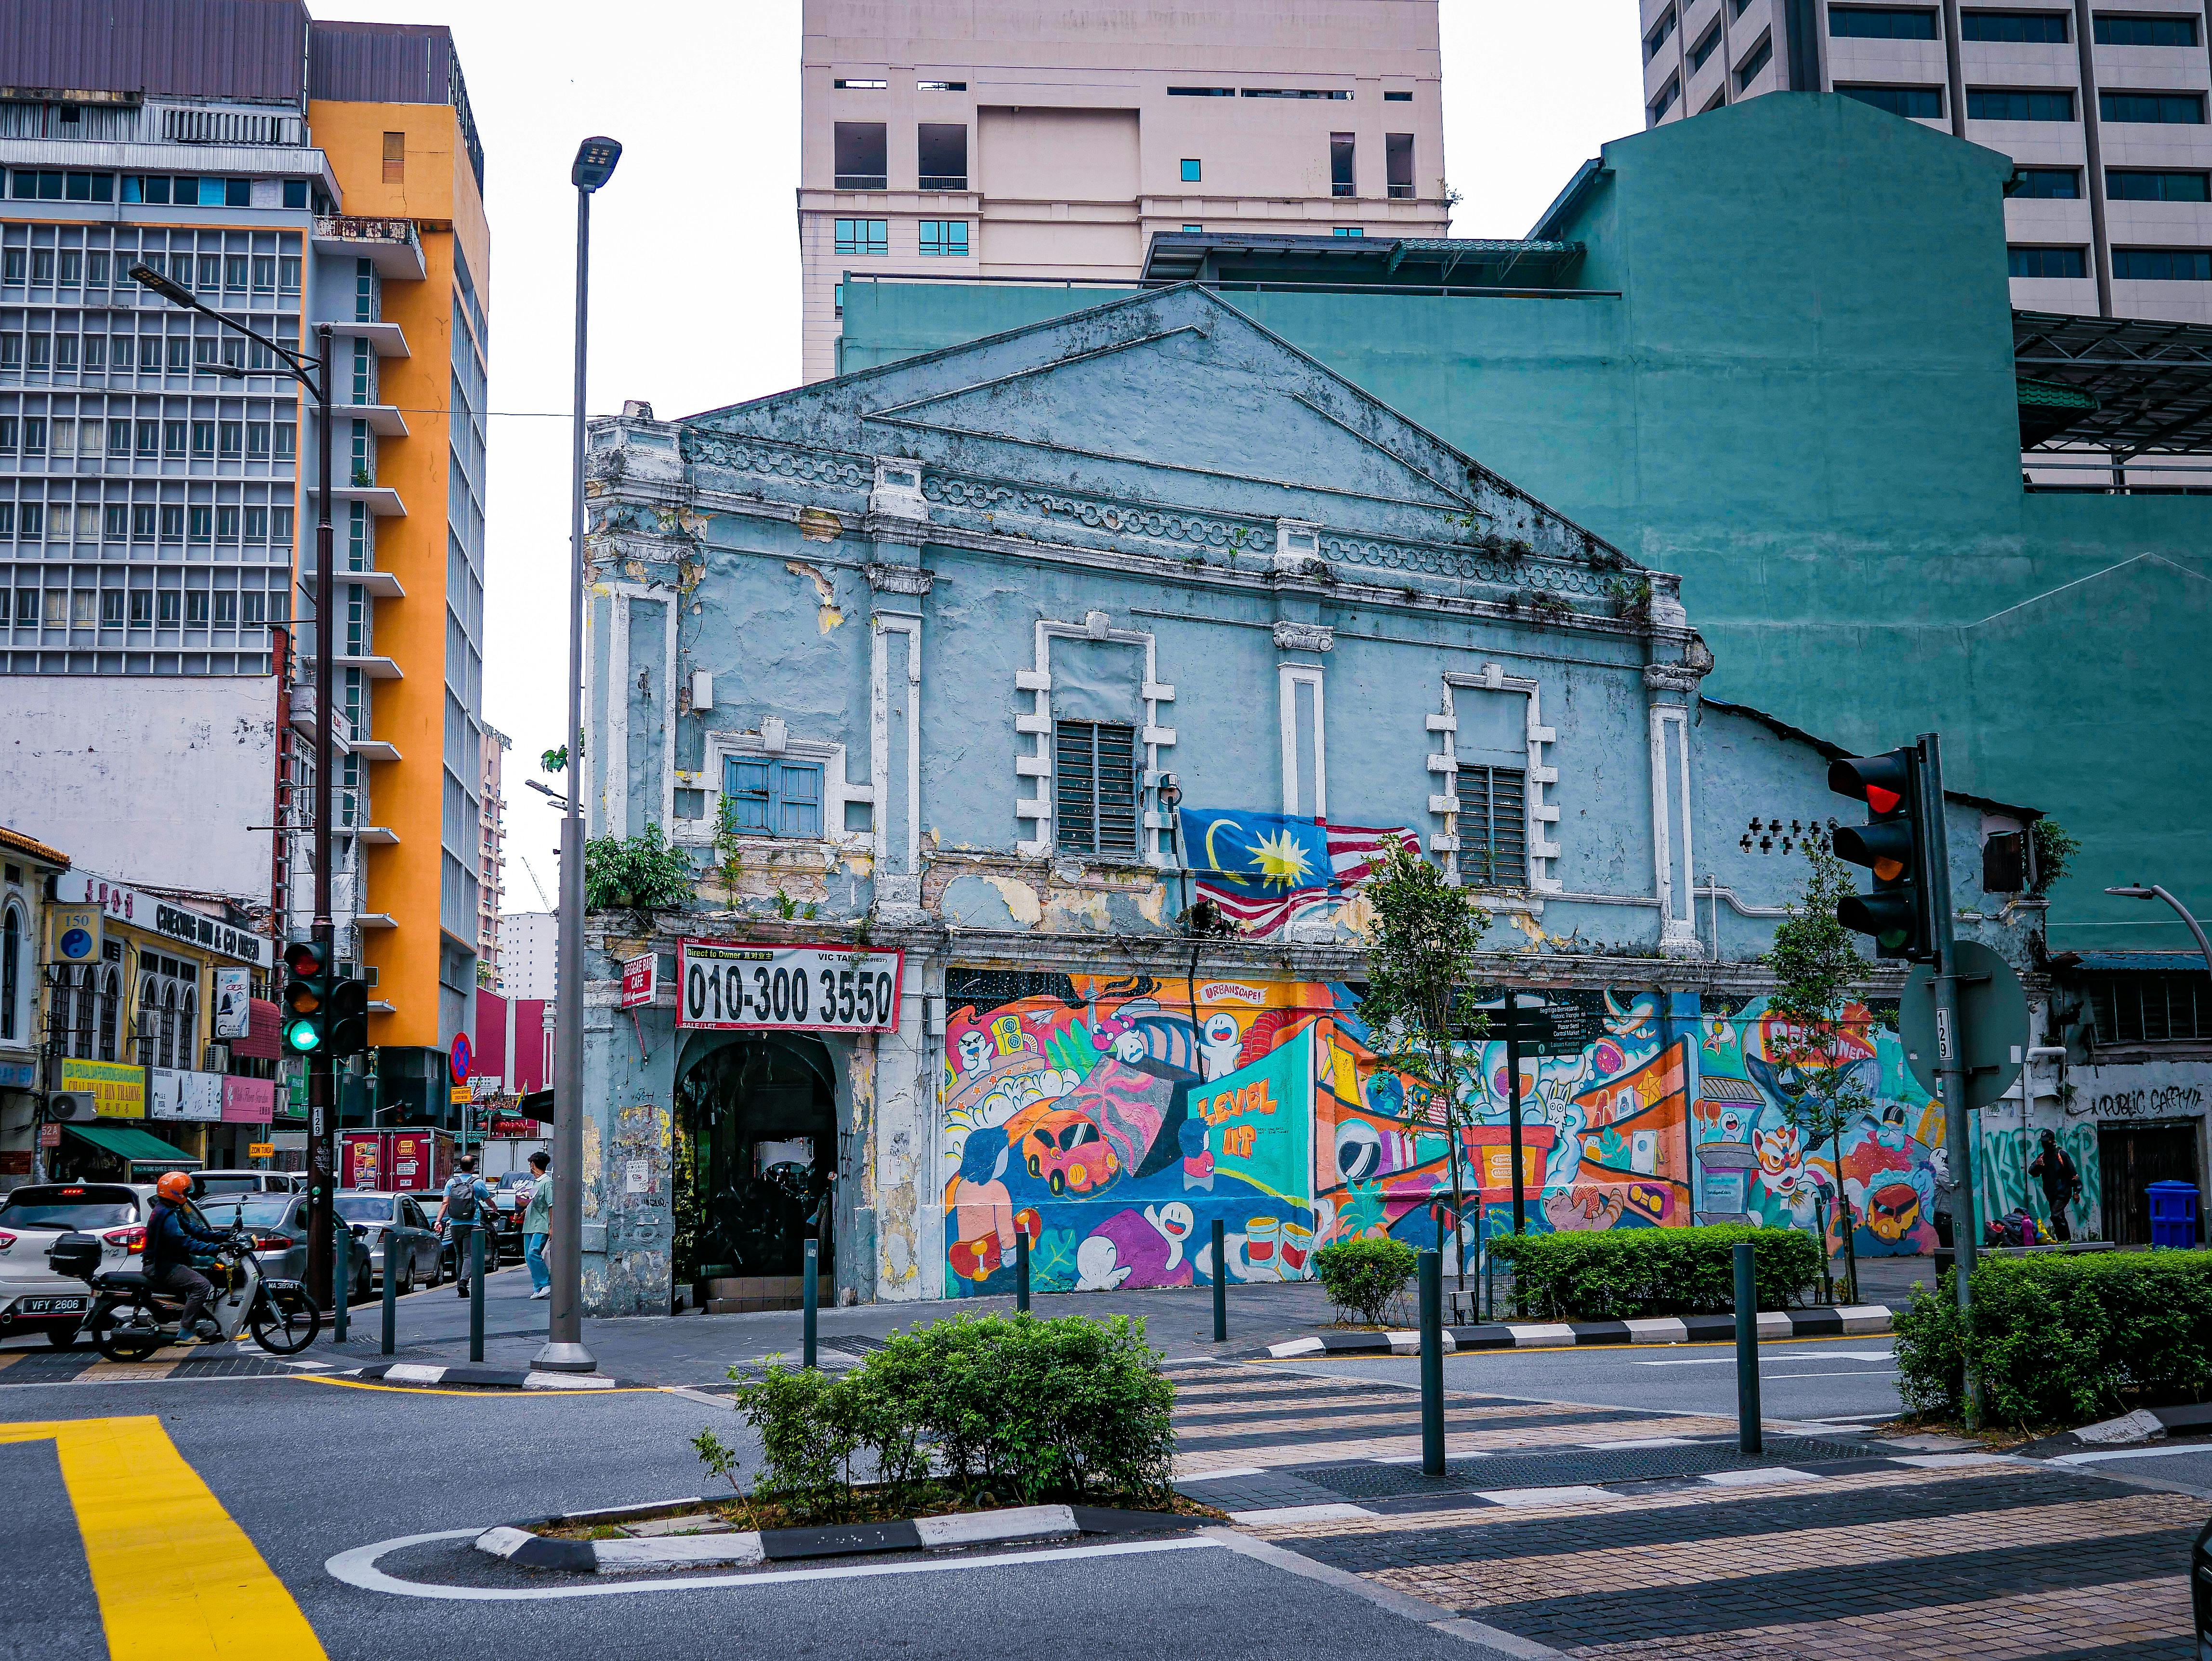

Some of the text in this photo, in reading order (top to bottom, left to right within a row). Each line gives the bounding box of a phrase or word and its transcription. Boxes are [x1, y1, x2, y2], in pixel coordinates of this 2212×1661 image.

[66, 915, 89, 926] 150
[157, 904, 197, 940] CHEONG
[198, 918, 213, 945] HIN
[214, 925, 222, 949] &
[224, 928, 237, 953] CO
[687, 948, 708, 957] Direct
[710, 949, 716, 958] to
[719, 950, 741, 959] Owner
[624, 957, 652, 977] REGGAE BAR
[632, 974, 644, 989] CAFE
[688, 963, 892, 1024] 010-300 3550
[1205, 984, 1261, 1002] URBANSCAPE!
[1938, 1012, 1947, 1057] 129
[105, 1083, 115, 1100] HIN
[117, 1084, 141, 1101] TRADING
[1198, 1077, 1277, 1127] LEVEL
[2099, 1090, 2145, 1117] PUBLIC
[42, 1126, 58, 1135] 52A
[1222, 1124, 1257, 1159] UP
[32, 1299, 79, 1310] VFY 2606
